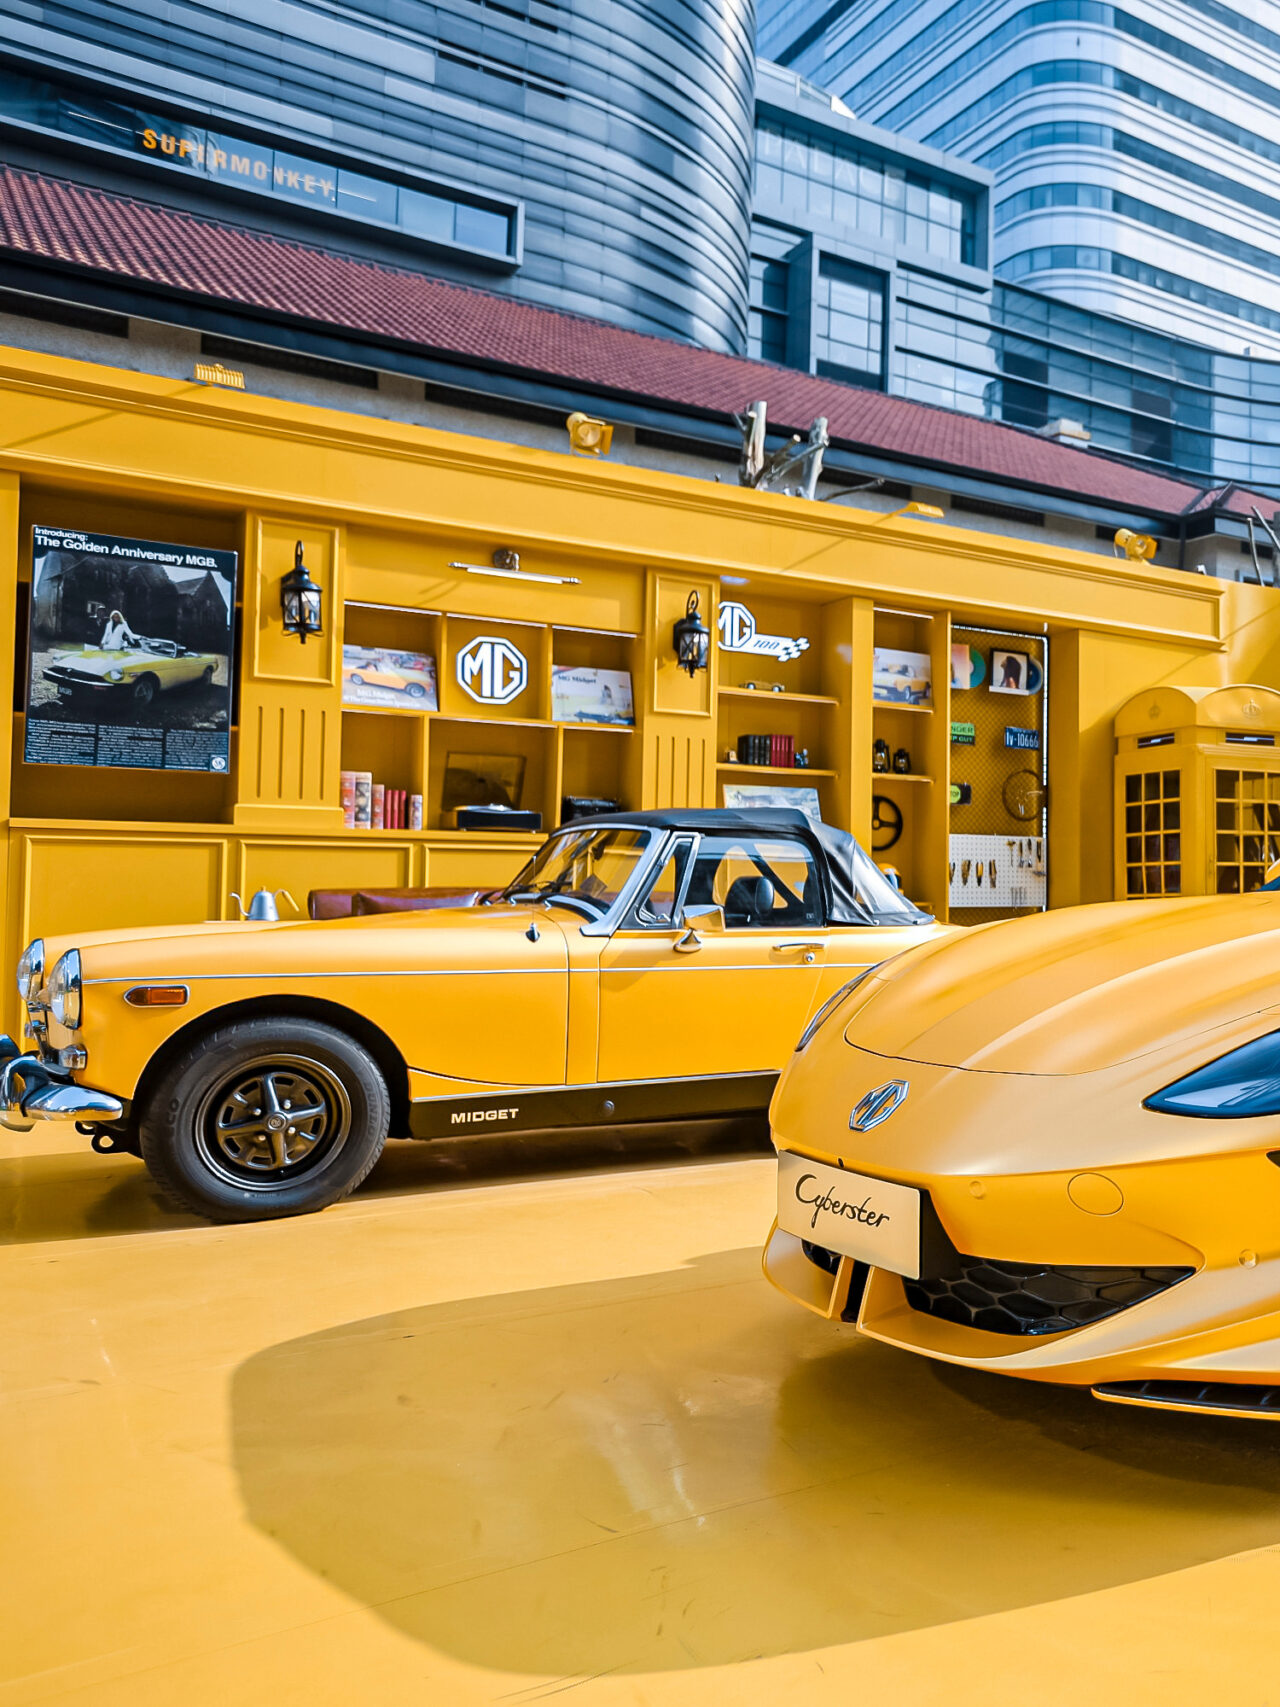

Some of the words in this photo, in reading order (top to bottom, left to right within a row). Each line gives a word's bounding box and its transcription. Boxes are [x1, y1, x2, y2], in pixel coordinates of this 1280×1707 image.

[35, 527, 89, 541] Introducing:
[35, 534, 60, 547] The
[63, 538, 109, 554] Golden
[111, 544, 183, 565] Anniversary
[185, 554, 218, 568] MGB.
[754, 640, 780, 650] 100
[464, 642, 521, 699] MG
[450, 1108, 520, 1124] MIDGET
[795, 1173, 890, 1229] Cyberster
